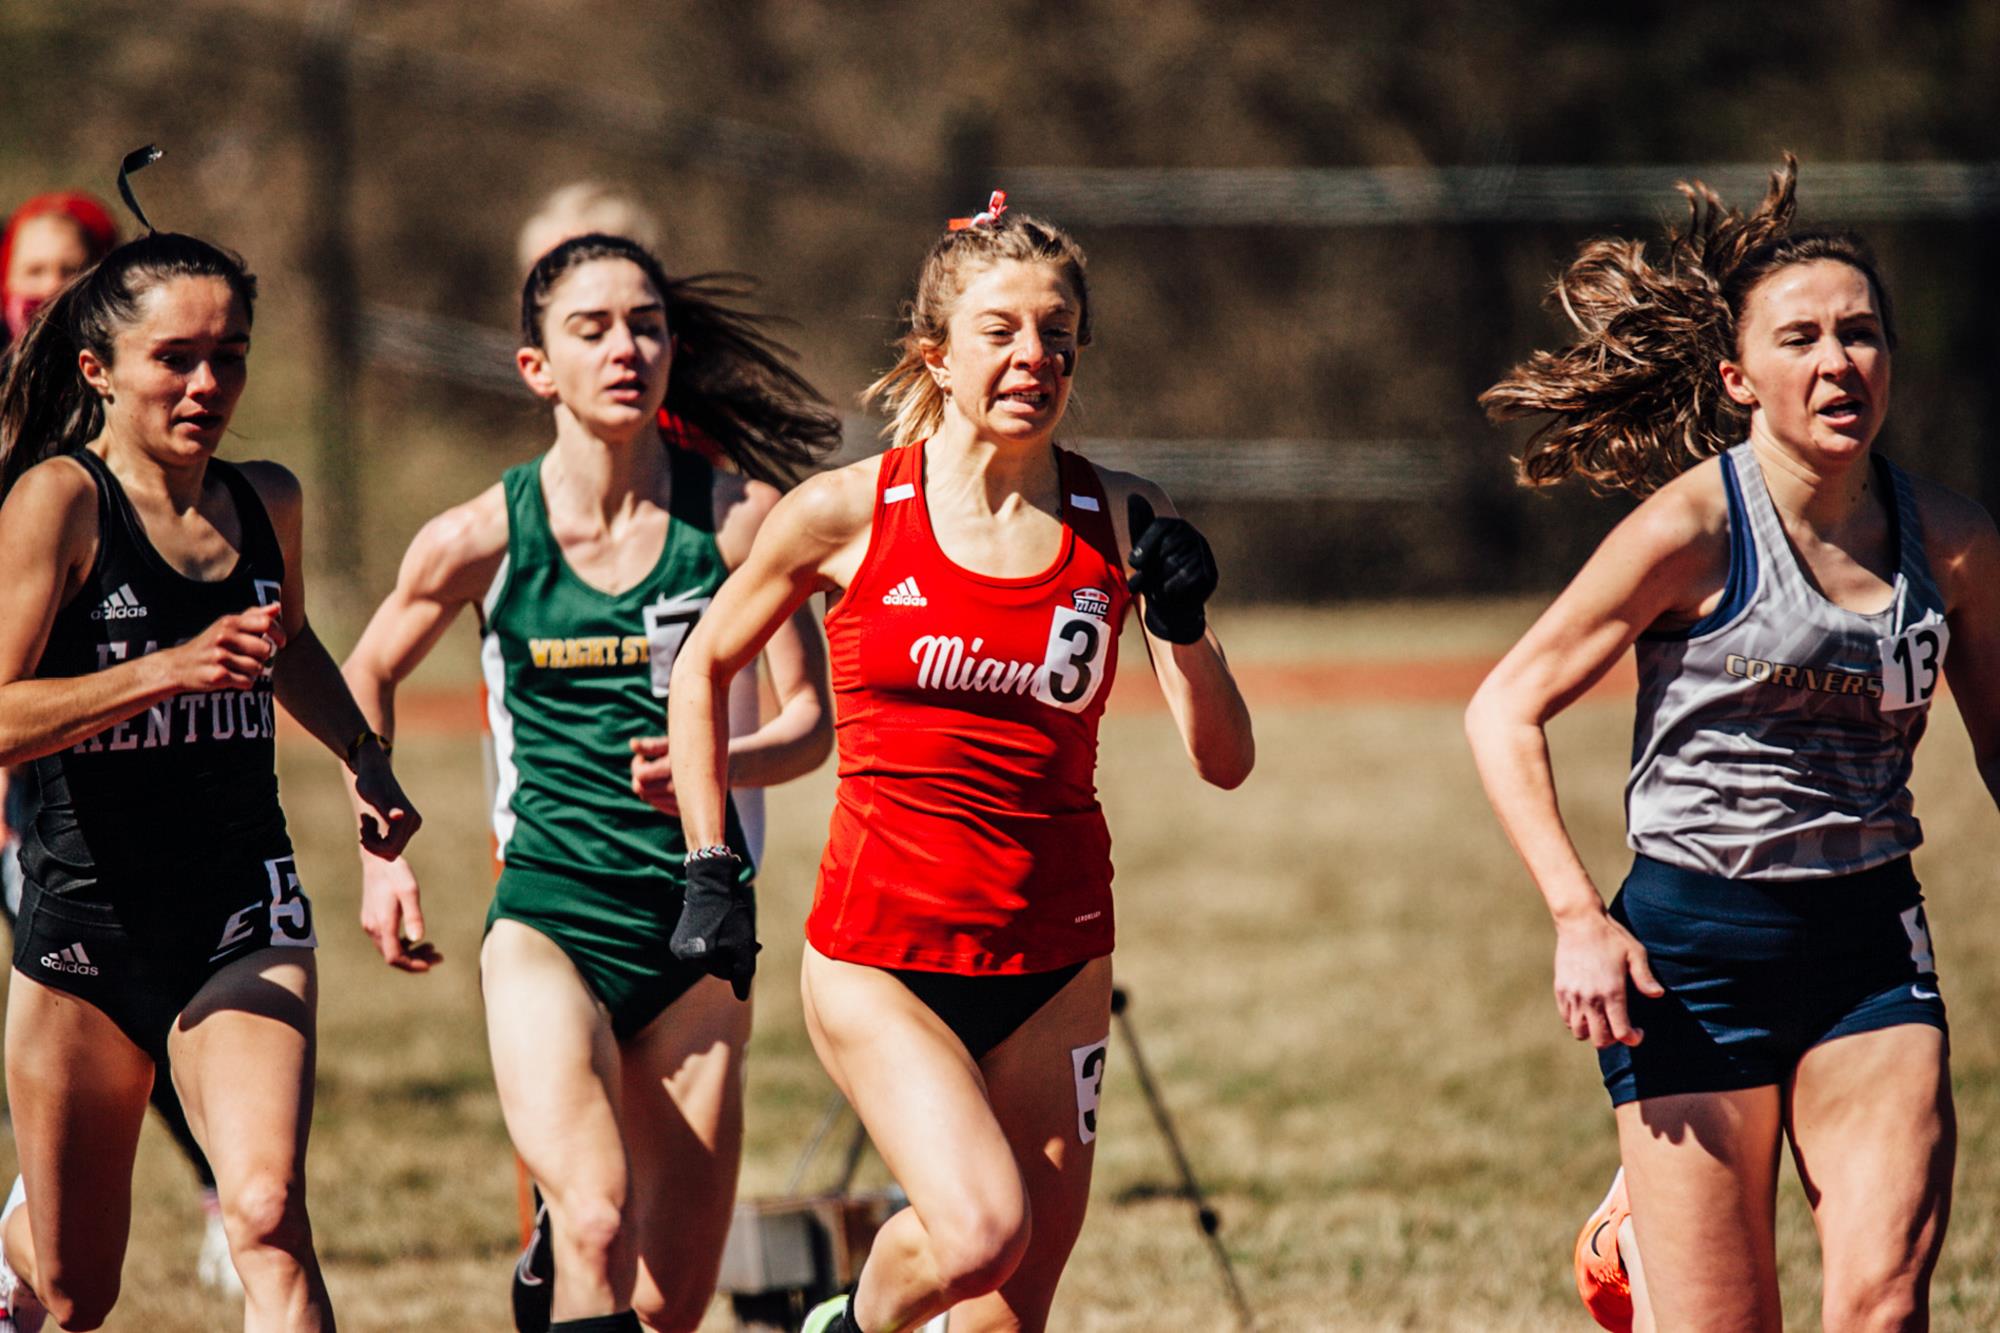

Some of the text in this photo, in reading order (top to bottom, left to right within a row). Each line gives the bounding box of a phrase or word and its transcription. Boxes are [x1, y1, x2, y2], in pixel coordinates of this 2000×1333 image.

[90, 604, 148, 620] adidas
[882, 594, 928, 607] adidas
[1075, 599, 1108, 615] MAC
[528, 637, 619, 668] WRIGHT
[1049, 619, 1099, 703] 3
[1893, 629, 1939, 704] 13
[73, 691, 275, 754] ENTUCK
[275, 861, 312, 941] 5
[40, 954, 99, 977] adidas
